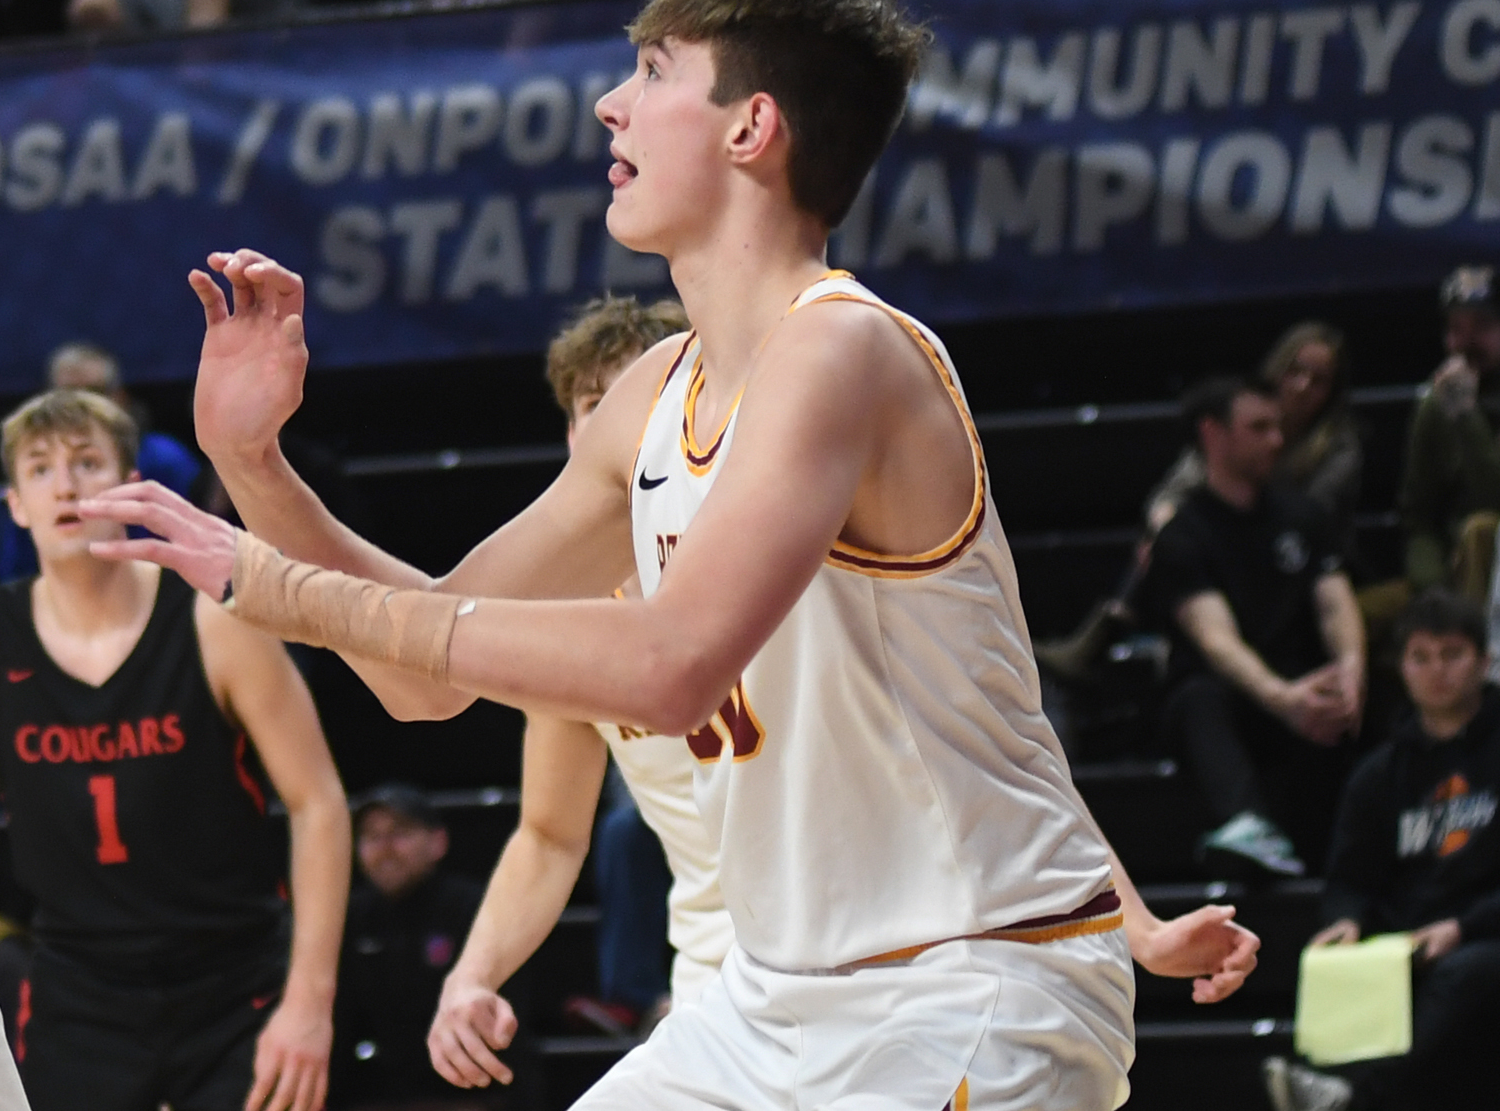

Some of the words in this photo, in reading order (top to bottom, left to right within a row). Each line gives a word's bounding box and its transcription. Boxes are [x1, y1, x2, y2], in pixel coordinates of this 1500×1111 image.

[288, 72, 628, 184] ONPOI
[903, 0, 1422, 132] MMUNITY
[833, 112, 1500, 268] AMPIONS
[14, 713, 186, 764] COUGARS
[88, 774, 129, 865] 1
